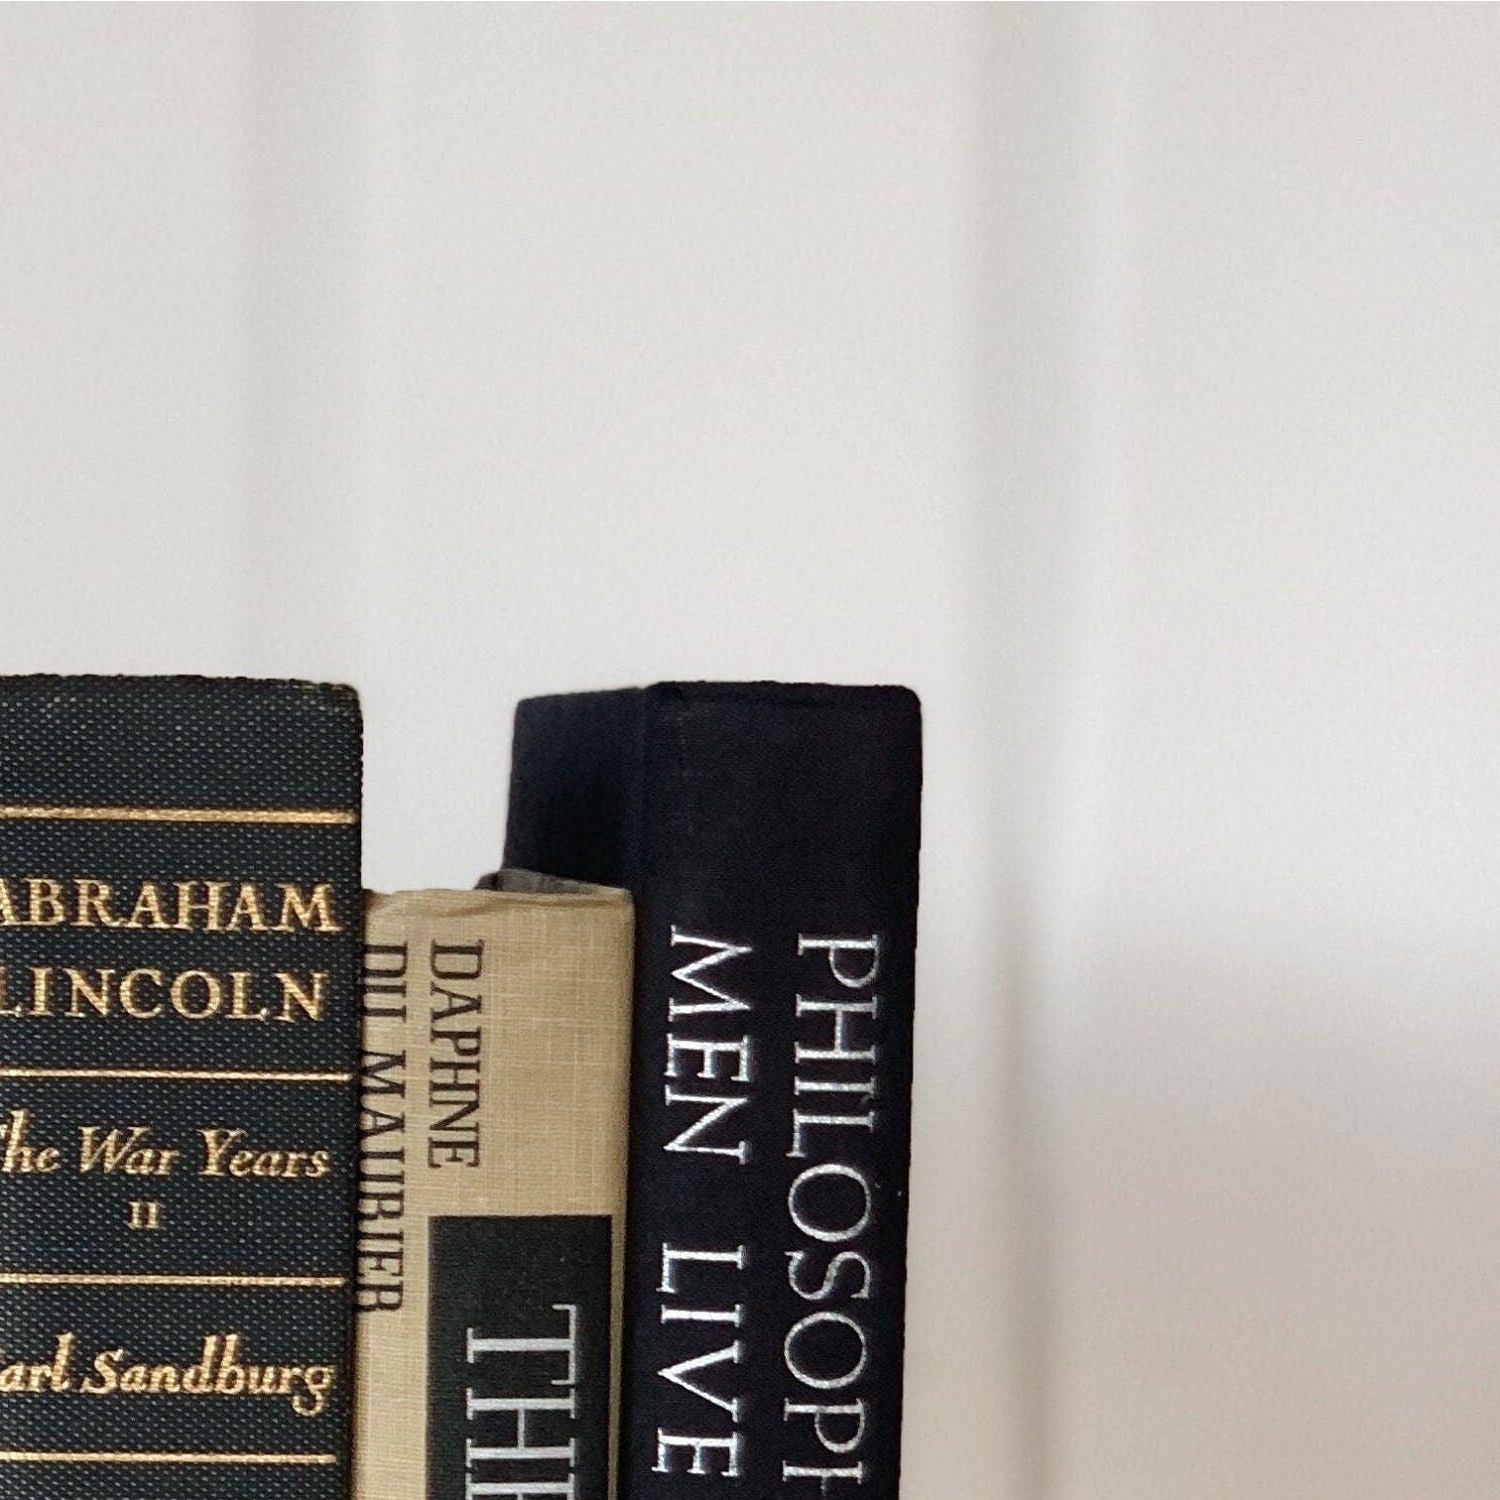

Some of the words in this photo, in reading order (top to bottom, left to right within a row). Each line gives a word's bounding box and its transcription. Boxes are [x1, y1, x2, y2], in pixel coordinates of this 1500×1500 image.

[361, 941, 408, 1025] DU
[427, 938, 484, 1169] DAPHNE
[663, 924, 754, 1166] MEN
[78, 1125, 179, 1178] War
[198, 1128, 331, 1179] Years
[356, 1050, 408, 1314] MAURIER
[80, 1335, 338, 1417] Sandburg
[650, 1243, 746, 1478] LIVE
